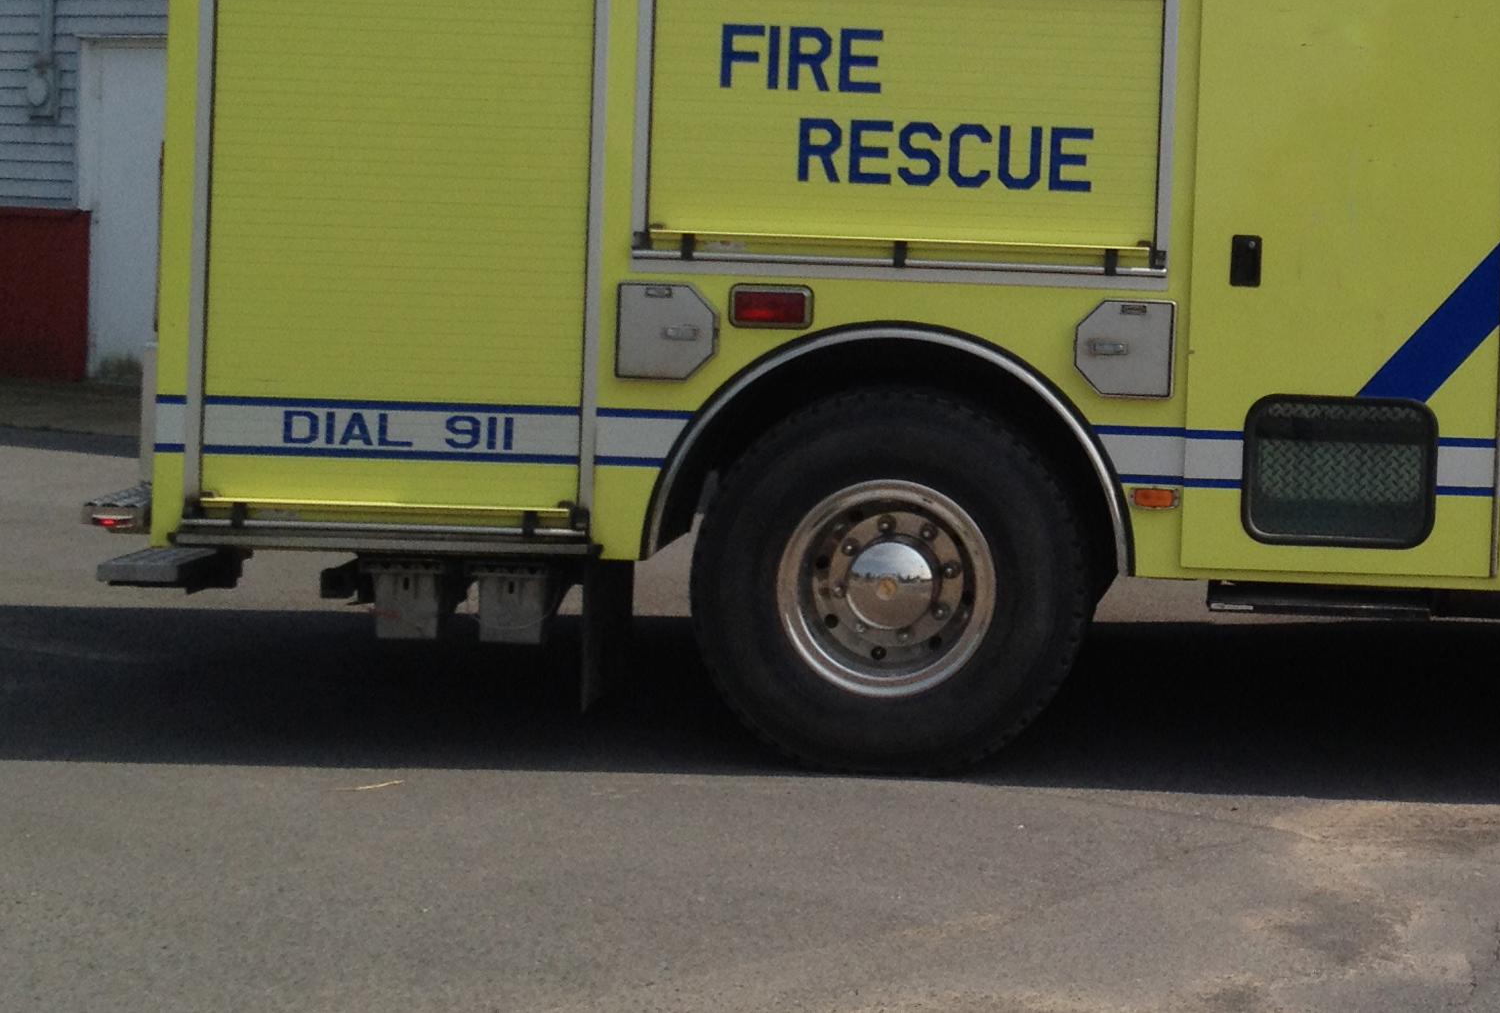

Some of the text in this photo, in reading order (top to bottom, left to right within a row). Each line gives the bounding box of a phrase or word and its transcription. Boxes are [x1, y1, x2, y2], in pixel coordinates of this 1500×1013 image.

[719, 23, 884, 94] FIRE
[797, 118, 1094, 192] RESCUE
[283, 410, 514, 450] DIAL 911
